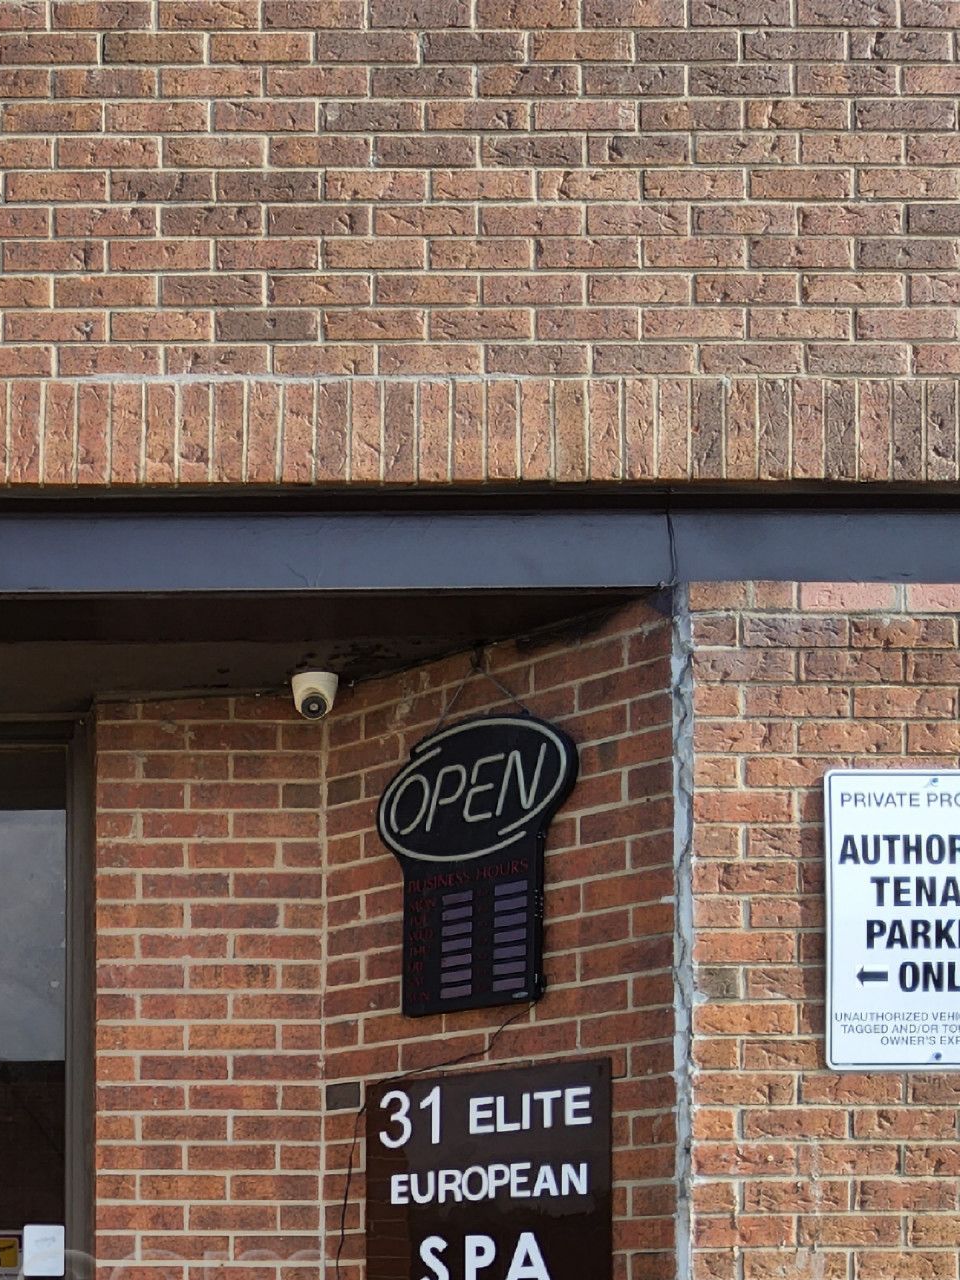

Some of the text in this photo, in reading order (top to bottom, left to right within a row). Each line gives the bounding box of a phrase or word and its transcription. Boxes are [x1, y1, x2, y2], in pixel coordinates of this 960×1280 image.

[390, 742, 547, 836] OPEN
[841, 791, 921, 808] PRIVATE
[870, 876, 960, 906] TENA
[866, 919, 960, 949] PARK
[899, 961, 960, 992] ONL
[835, 1012, 960, 1021] UNAUTHORIZED VEHI
[841, 1024, 960, 1034] TAGGED AND/OR TO
[880, 1035, 937, 1046] OWNER'S
[378, 1085, 592, 1149] 31 ELITE
[390, 1162, 588, 1205] EUROPEAN
